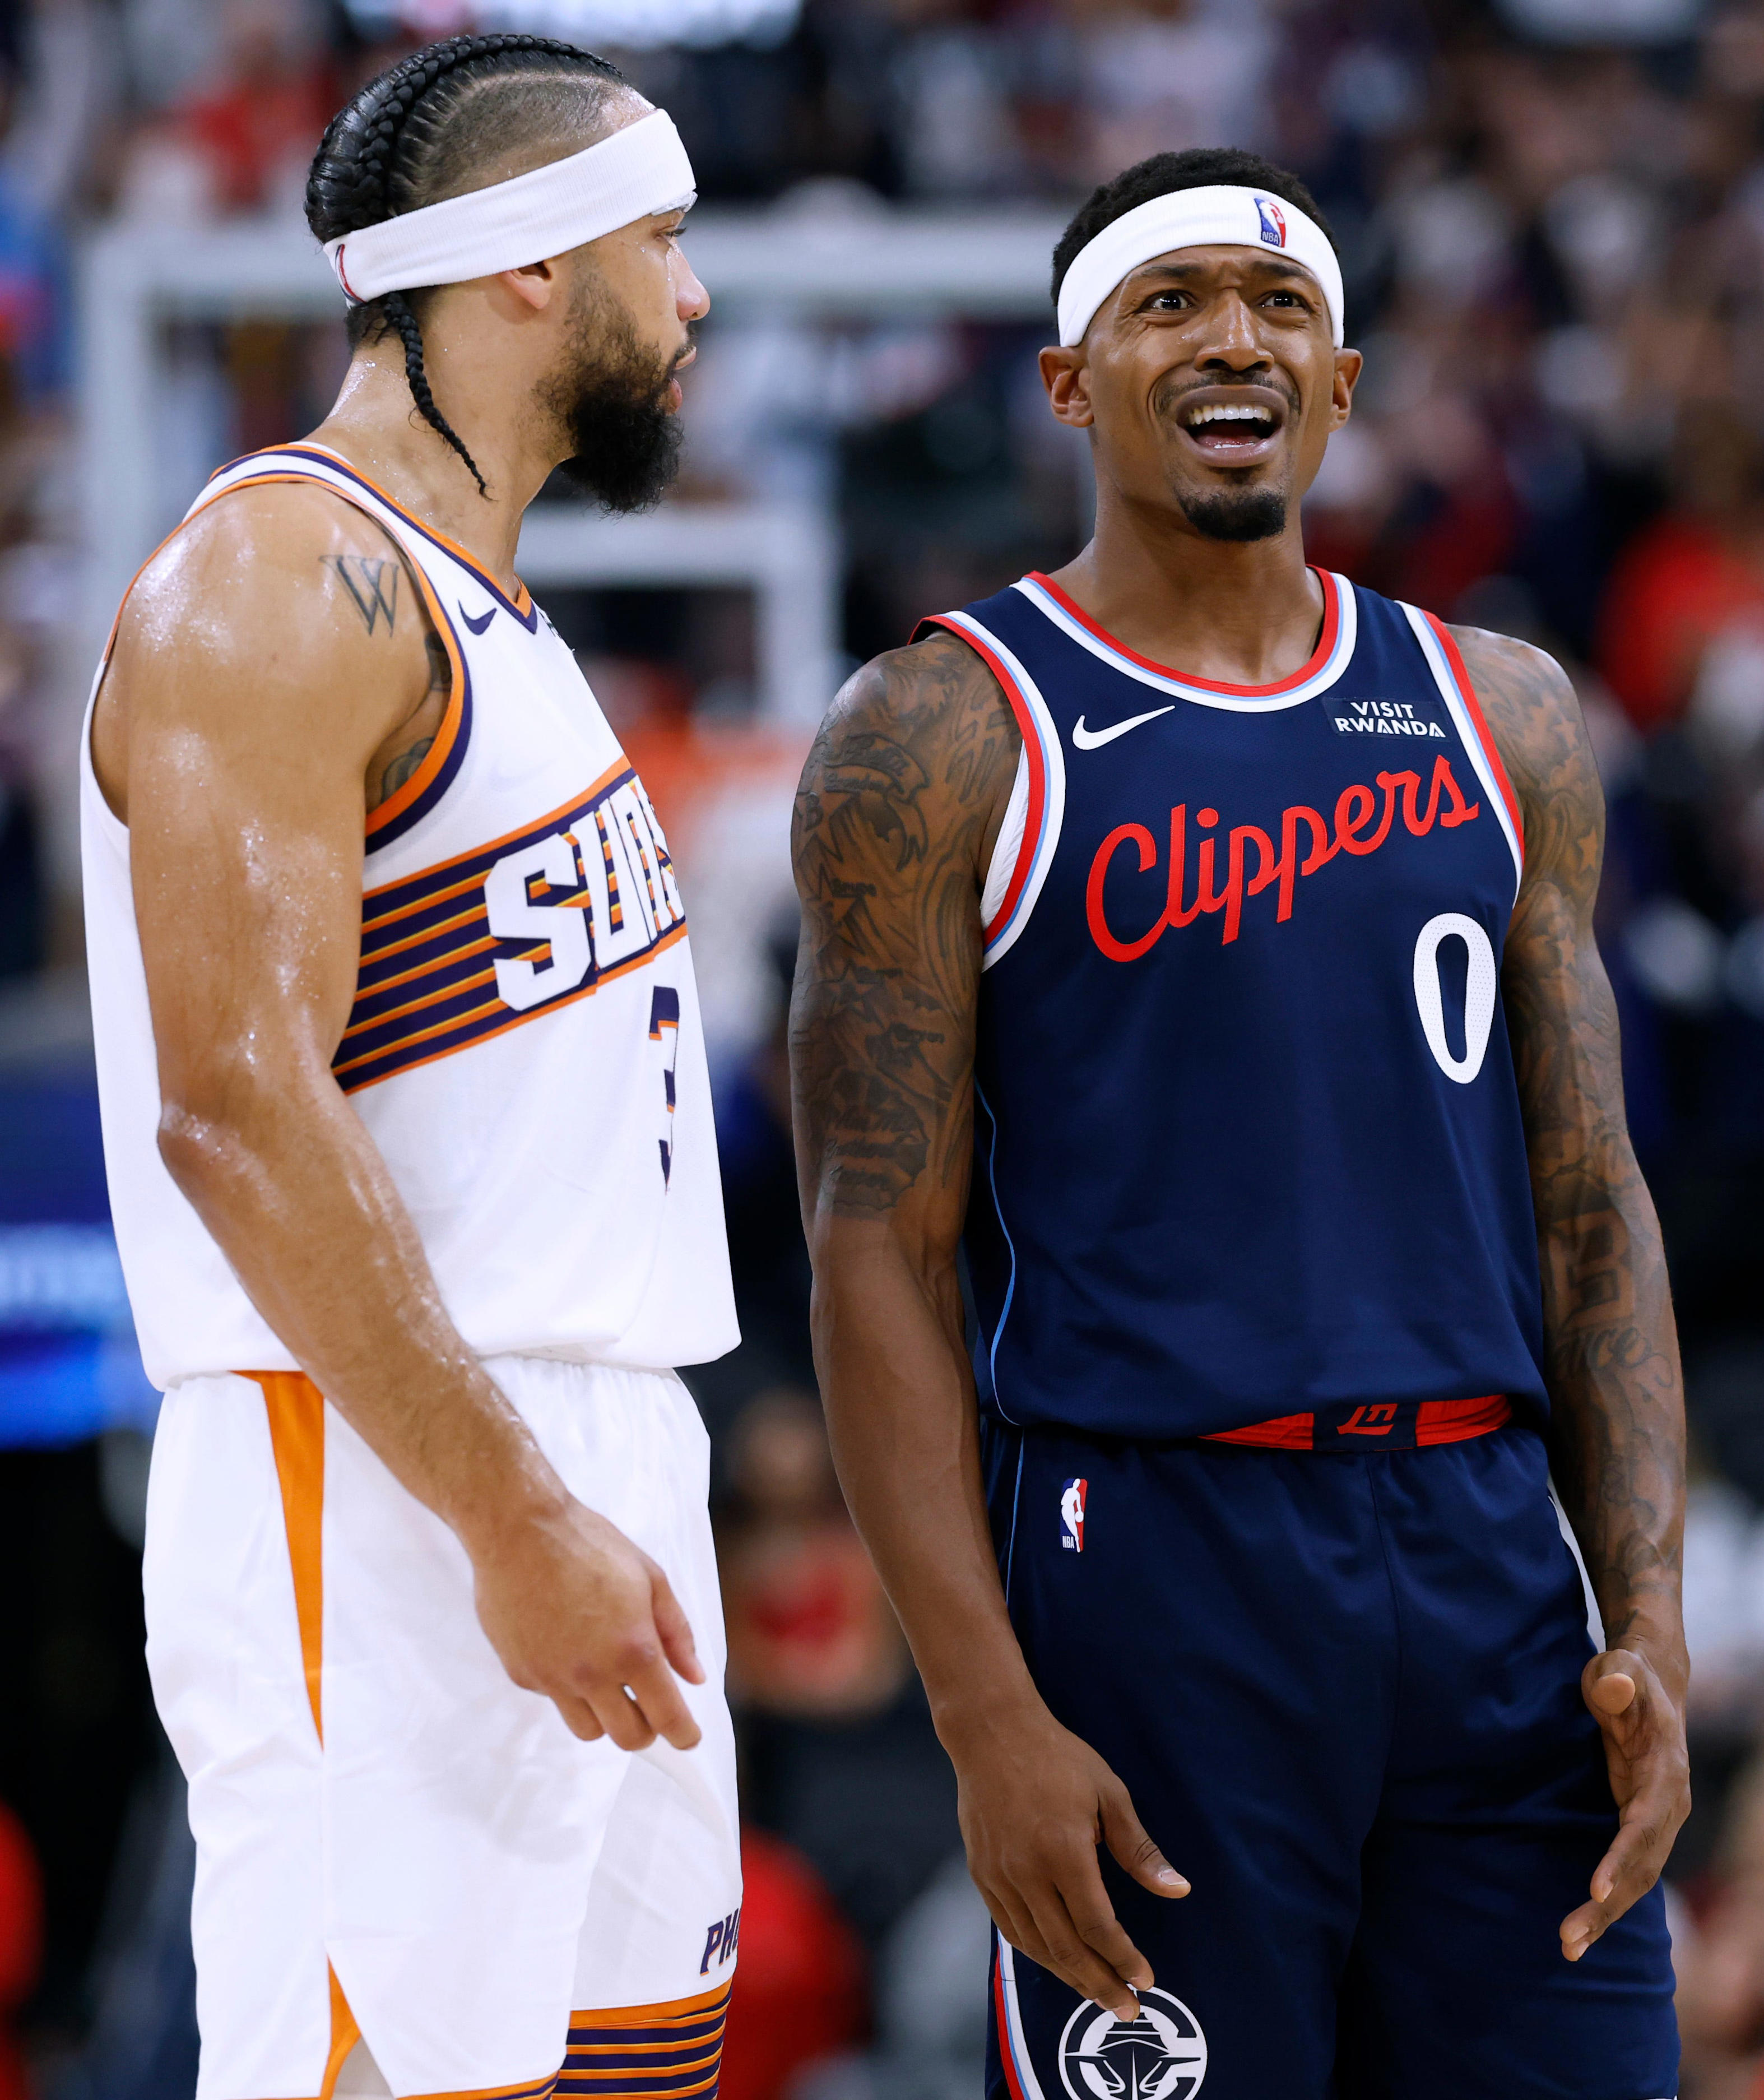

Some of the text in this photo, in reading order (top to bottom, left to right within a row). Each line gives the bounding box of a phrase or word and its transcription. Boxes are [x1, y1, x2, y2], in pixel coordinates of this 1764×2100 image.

[1262, 231, 1279, 244] NBA
[1350, 701, 1414, 719] VISIT
[1334, 717, 1446, 738] RWANDA
[1086, 754, 1479, 962] Clippers
[1413, 912, 1497, 1084] 0
[1062, 1535, 1075, 1549] NBA
